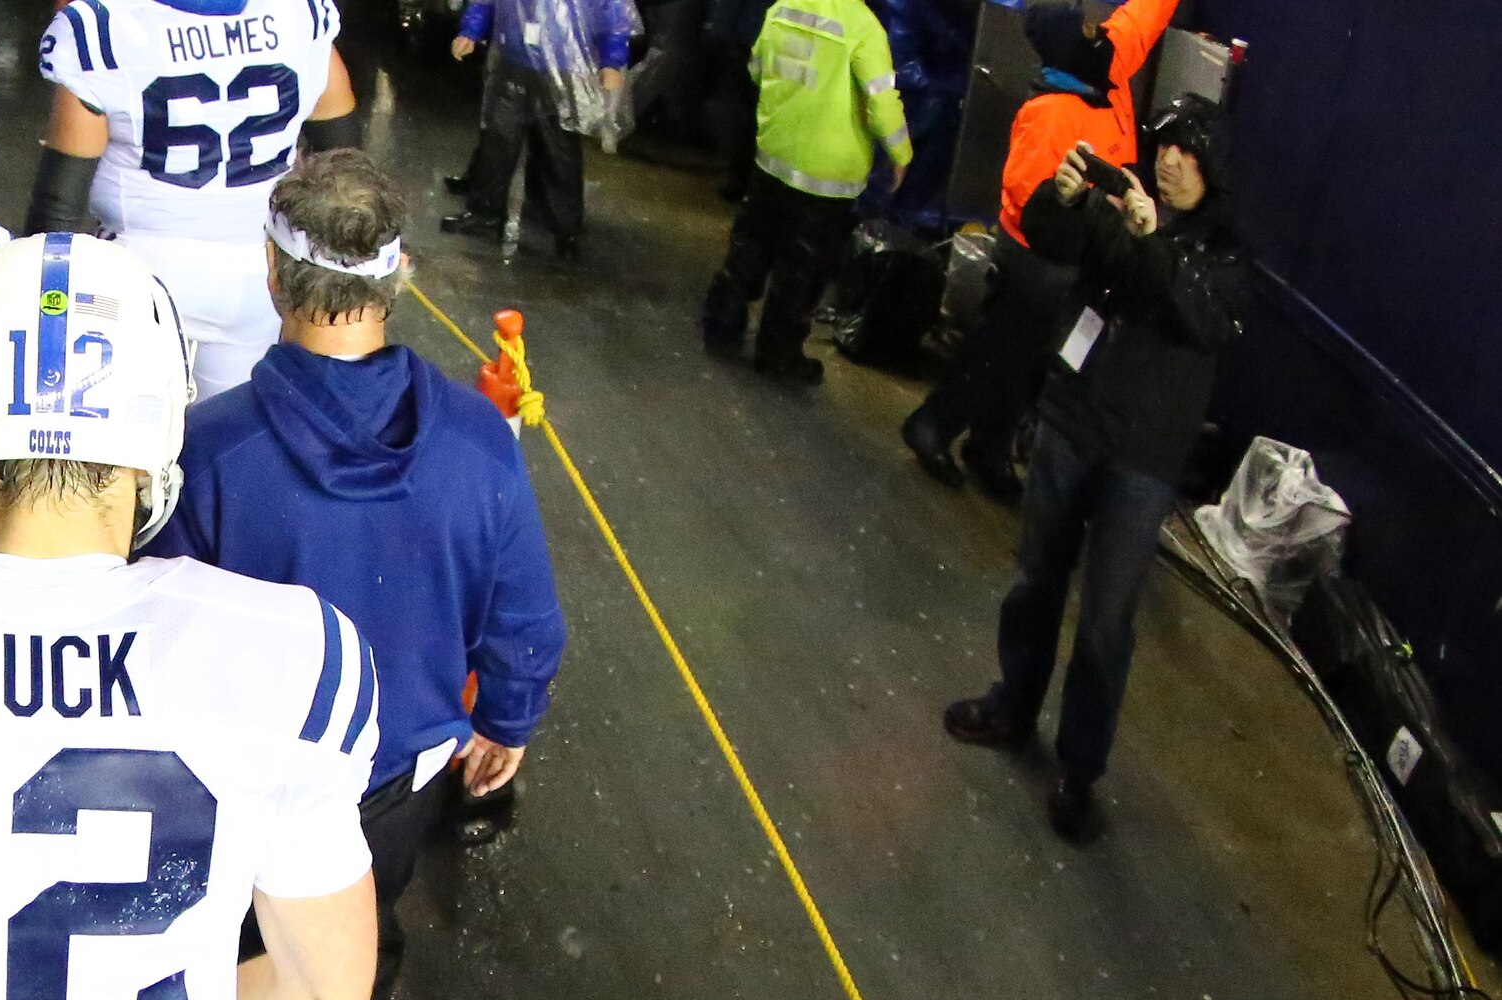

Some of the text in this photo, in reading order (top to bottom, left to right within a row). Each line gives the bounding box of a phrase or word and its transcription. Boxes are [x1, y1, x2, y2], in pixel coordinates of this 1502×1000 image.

[166, 15, 279, 63] HOLMES
[140, 62, 299, 190] 62
[7, 329, 113, 418] 12
[29, 429, 71, 455] COLTS
